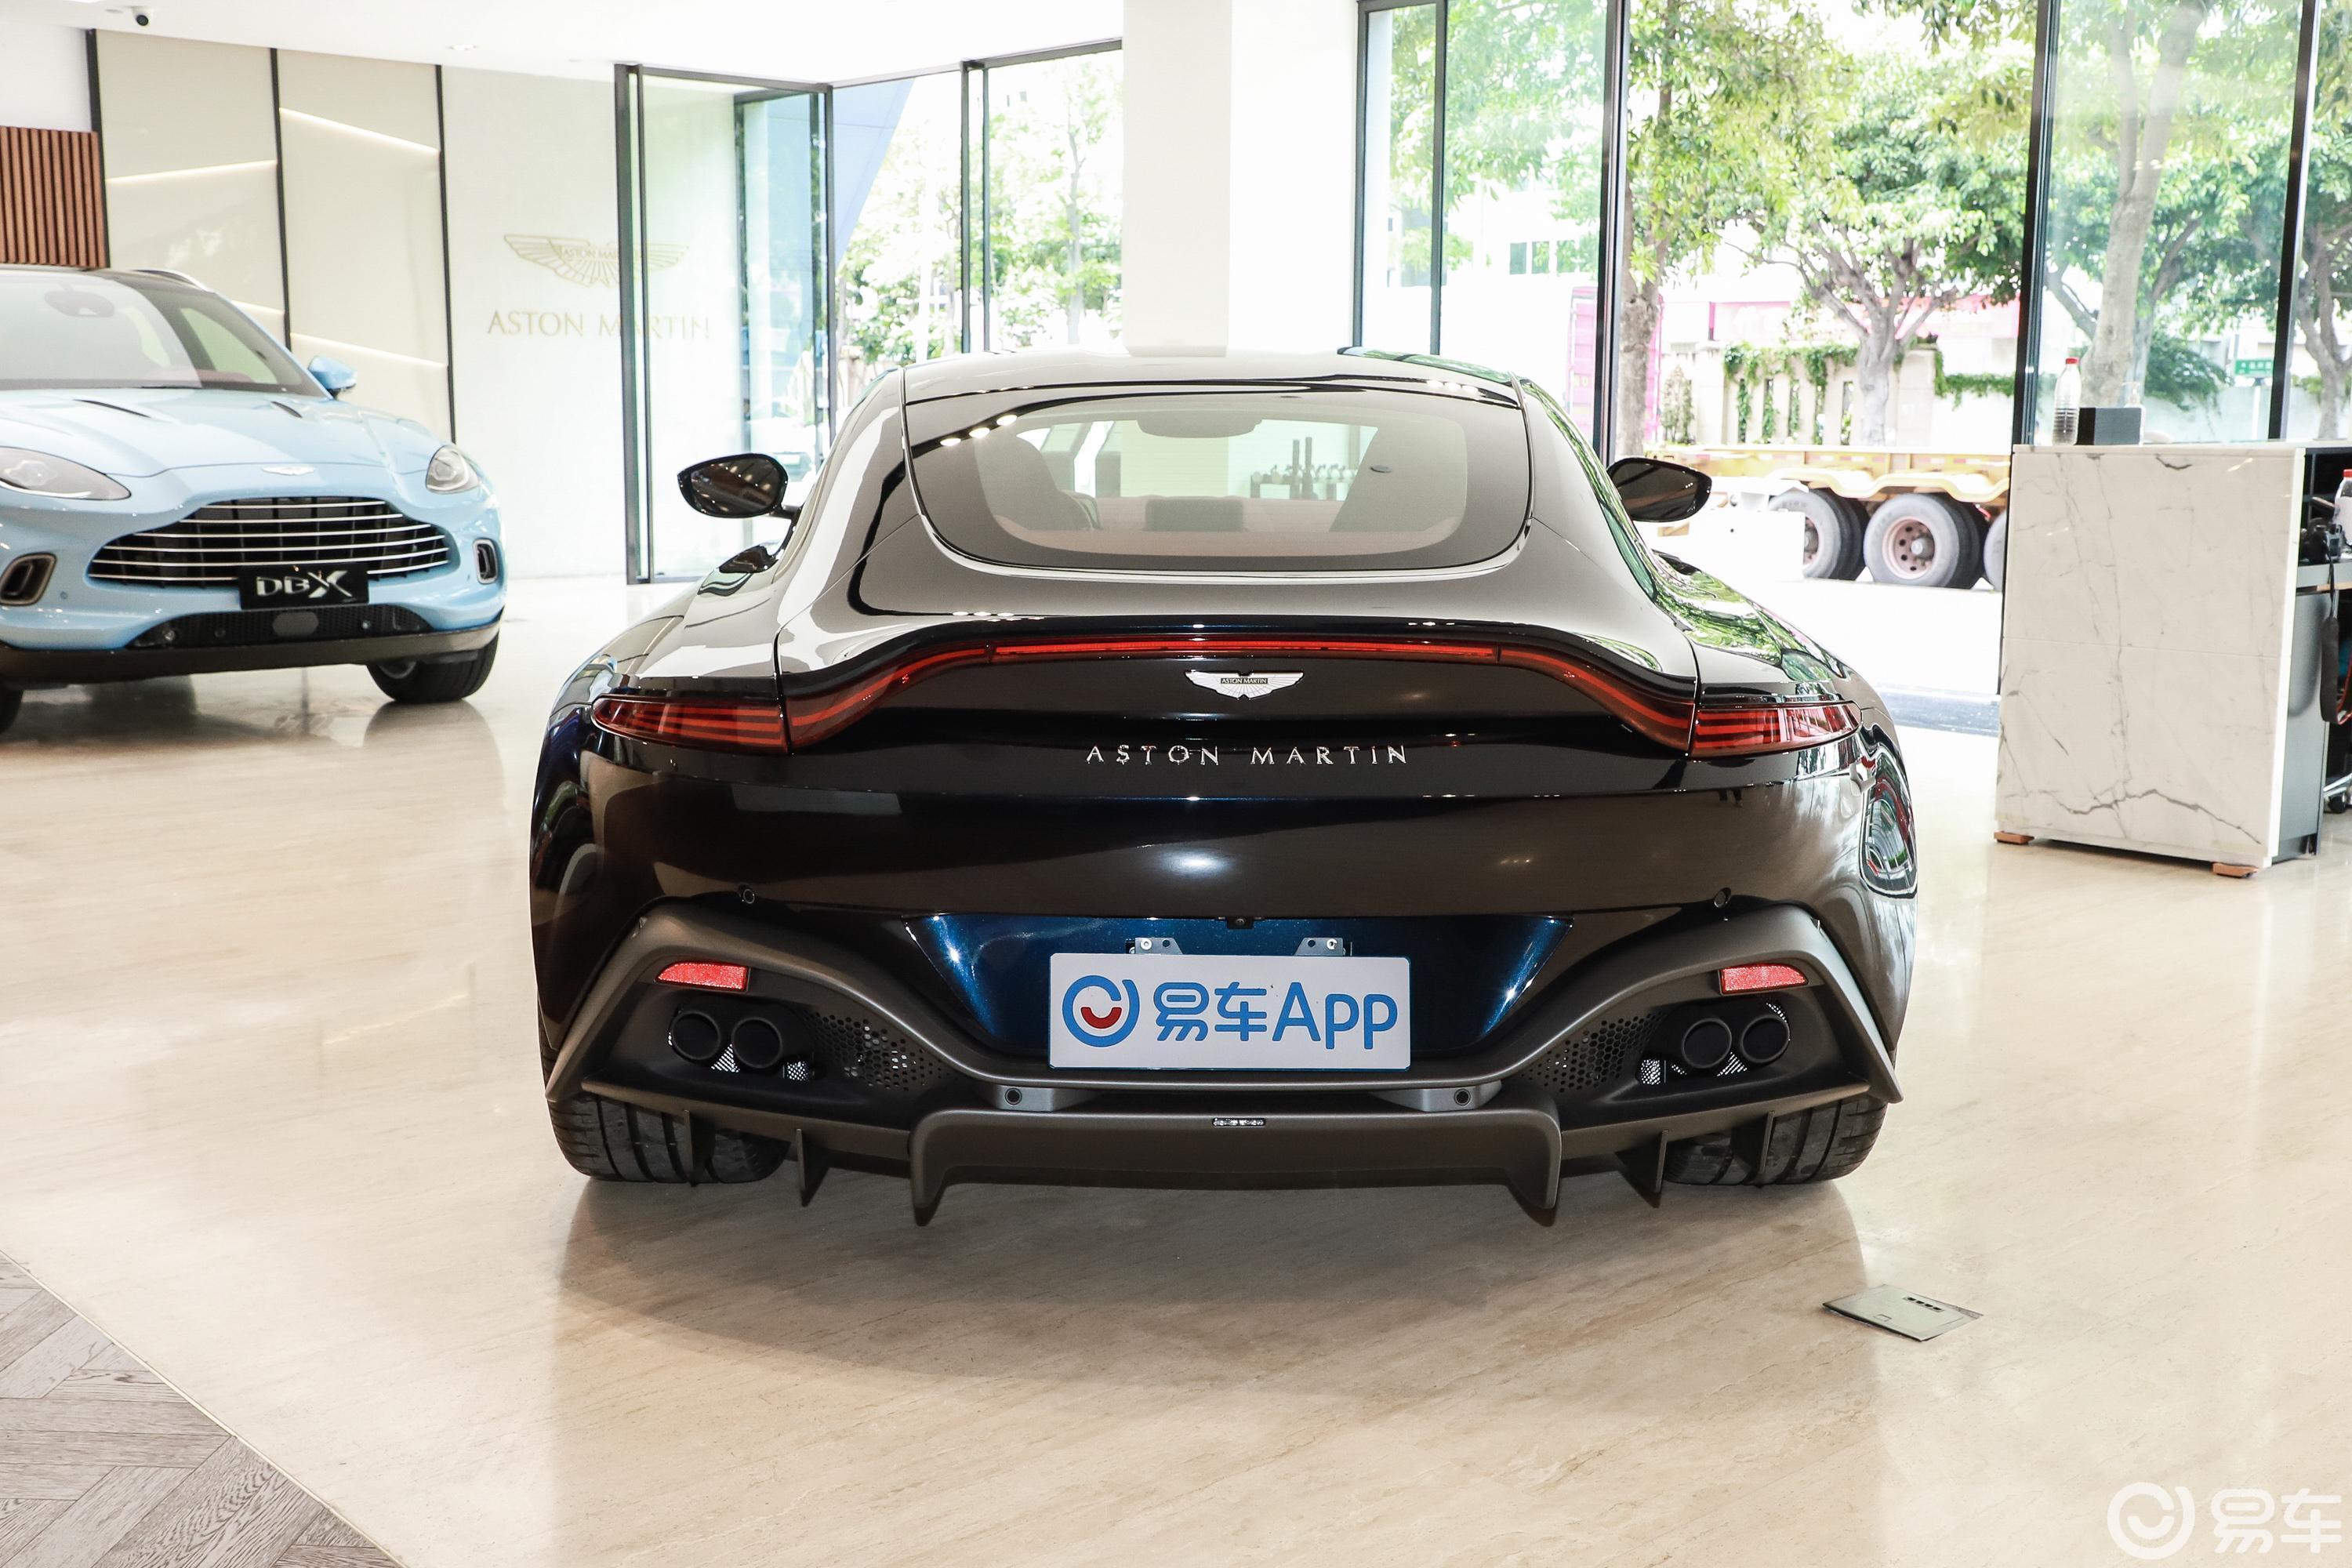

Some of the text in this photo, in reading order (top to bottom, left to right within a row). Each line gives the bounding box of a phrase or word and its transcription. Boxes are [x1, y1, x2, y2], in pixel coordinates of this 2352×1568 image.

[488, 310, 710, 339] ASTON MRTIN
[256, 571, 352, 598] DBX
[1085, 745, 1407, 765] ASTON MARTIN
[1153, 982, 1399, 1050] 易车App
